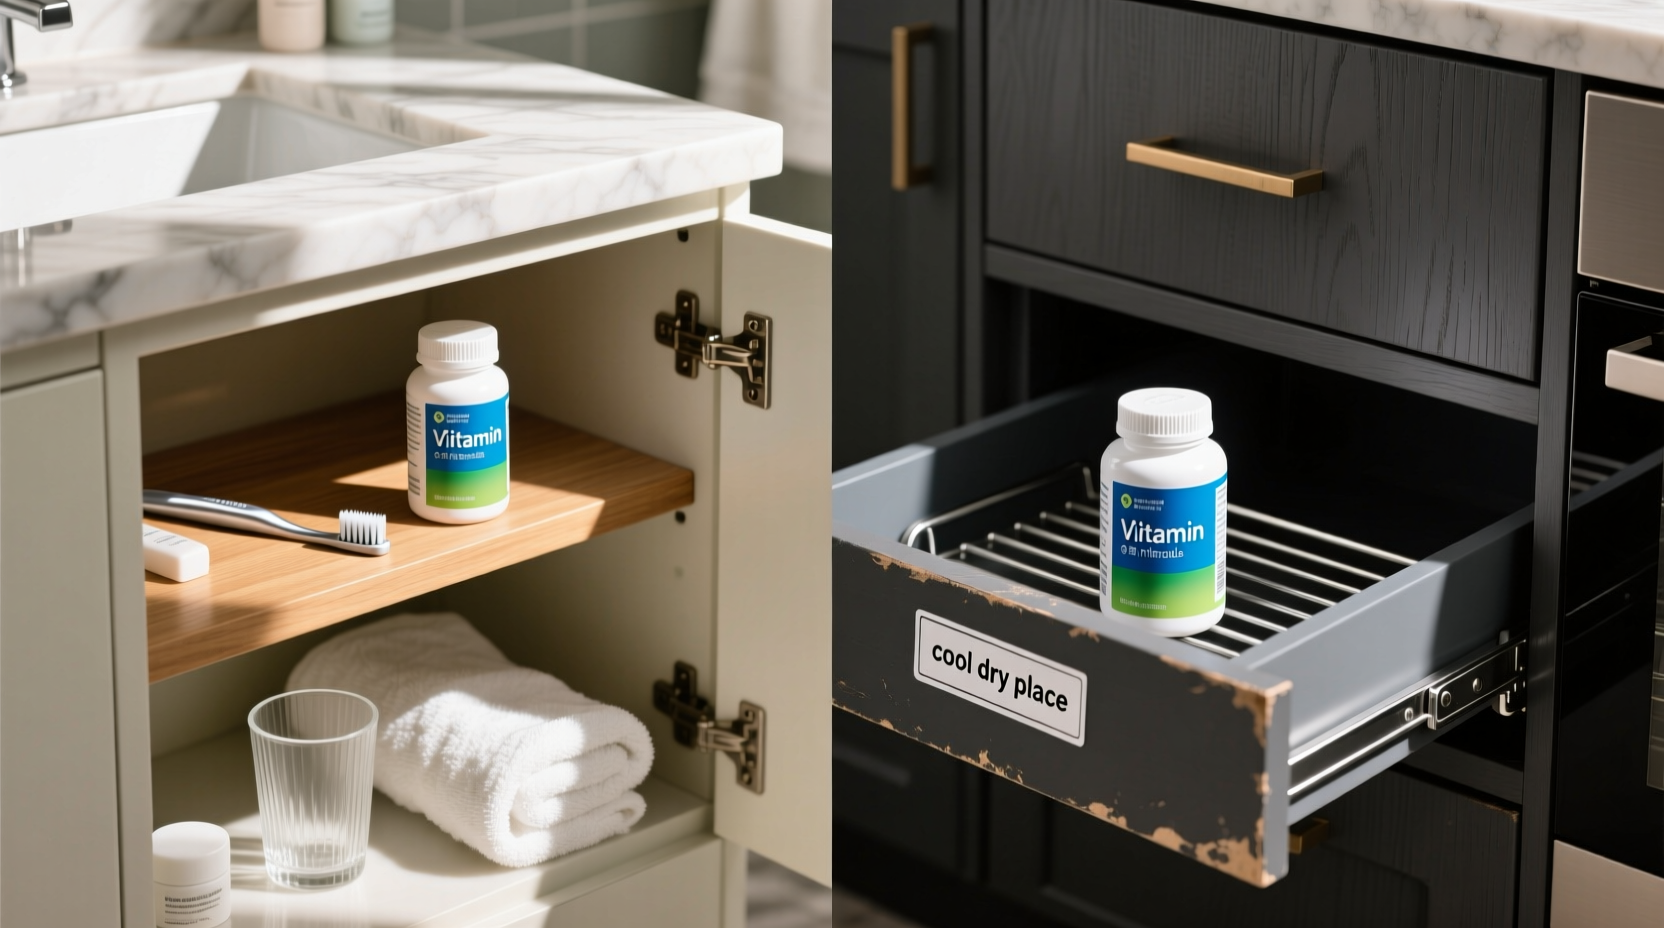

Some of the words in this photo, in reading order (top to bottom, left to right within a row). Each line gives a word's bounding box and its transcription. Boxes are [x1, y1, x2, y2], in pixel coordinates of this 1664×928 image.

[932, 644, 972, 674] cool
[977, 658, 1010, 693] dry
[1014, 674, 1068, 712] place
